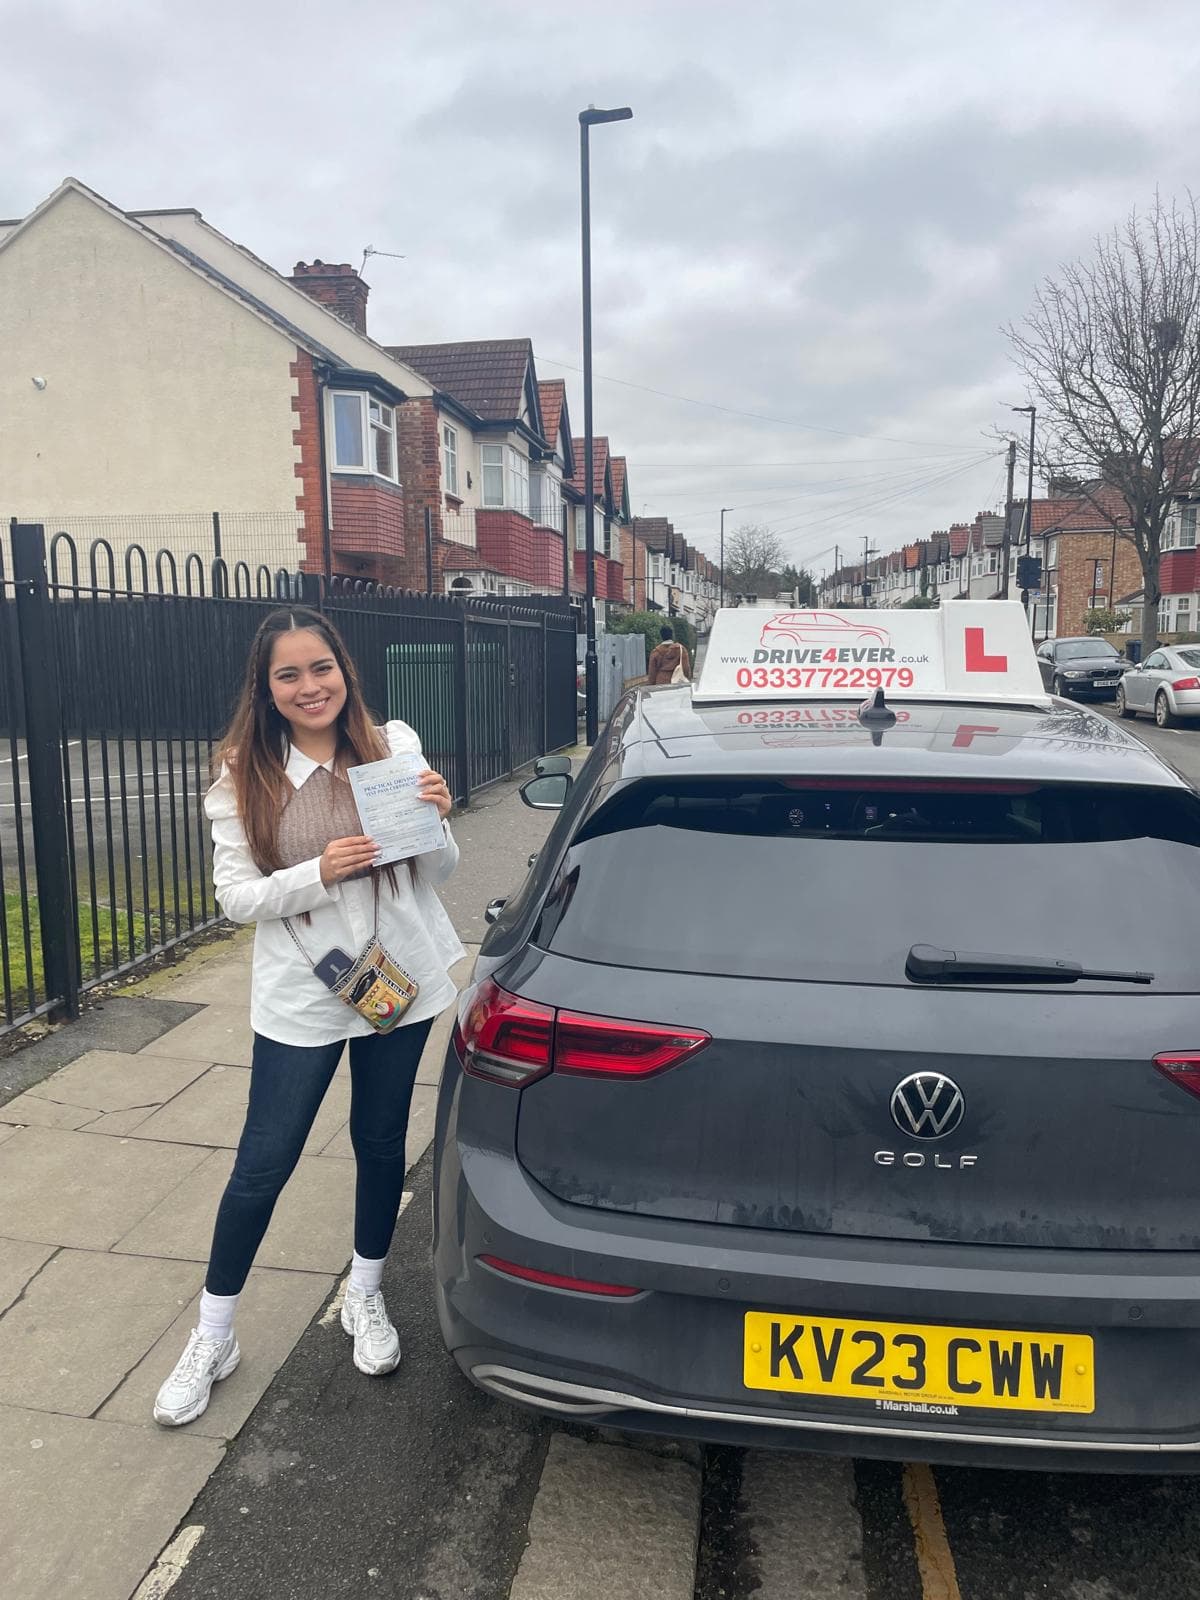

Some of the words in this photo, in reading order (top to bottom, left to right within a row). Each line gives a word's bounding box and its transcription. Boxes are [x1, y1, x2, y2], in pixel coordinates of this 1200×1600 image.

[964, 627, 1008, 673] L
[735, 667, 914, 689] 03337722979
[873, 1151, 978, 1169] GOLF
[769, 1322, 927, 1390] KV23
[947, 1337, 1065, 1400] CWW
[883, 1400, 959, 1416] Marshall.co.uk
